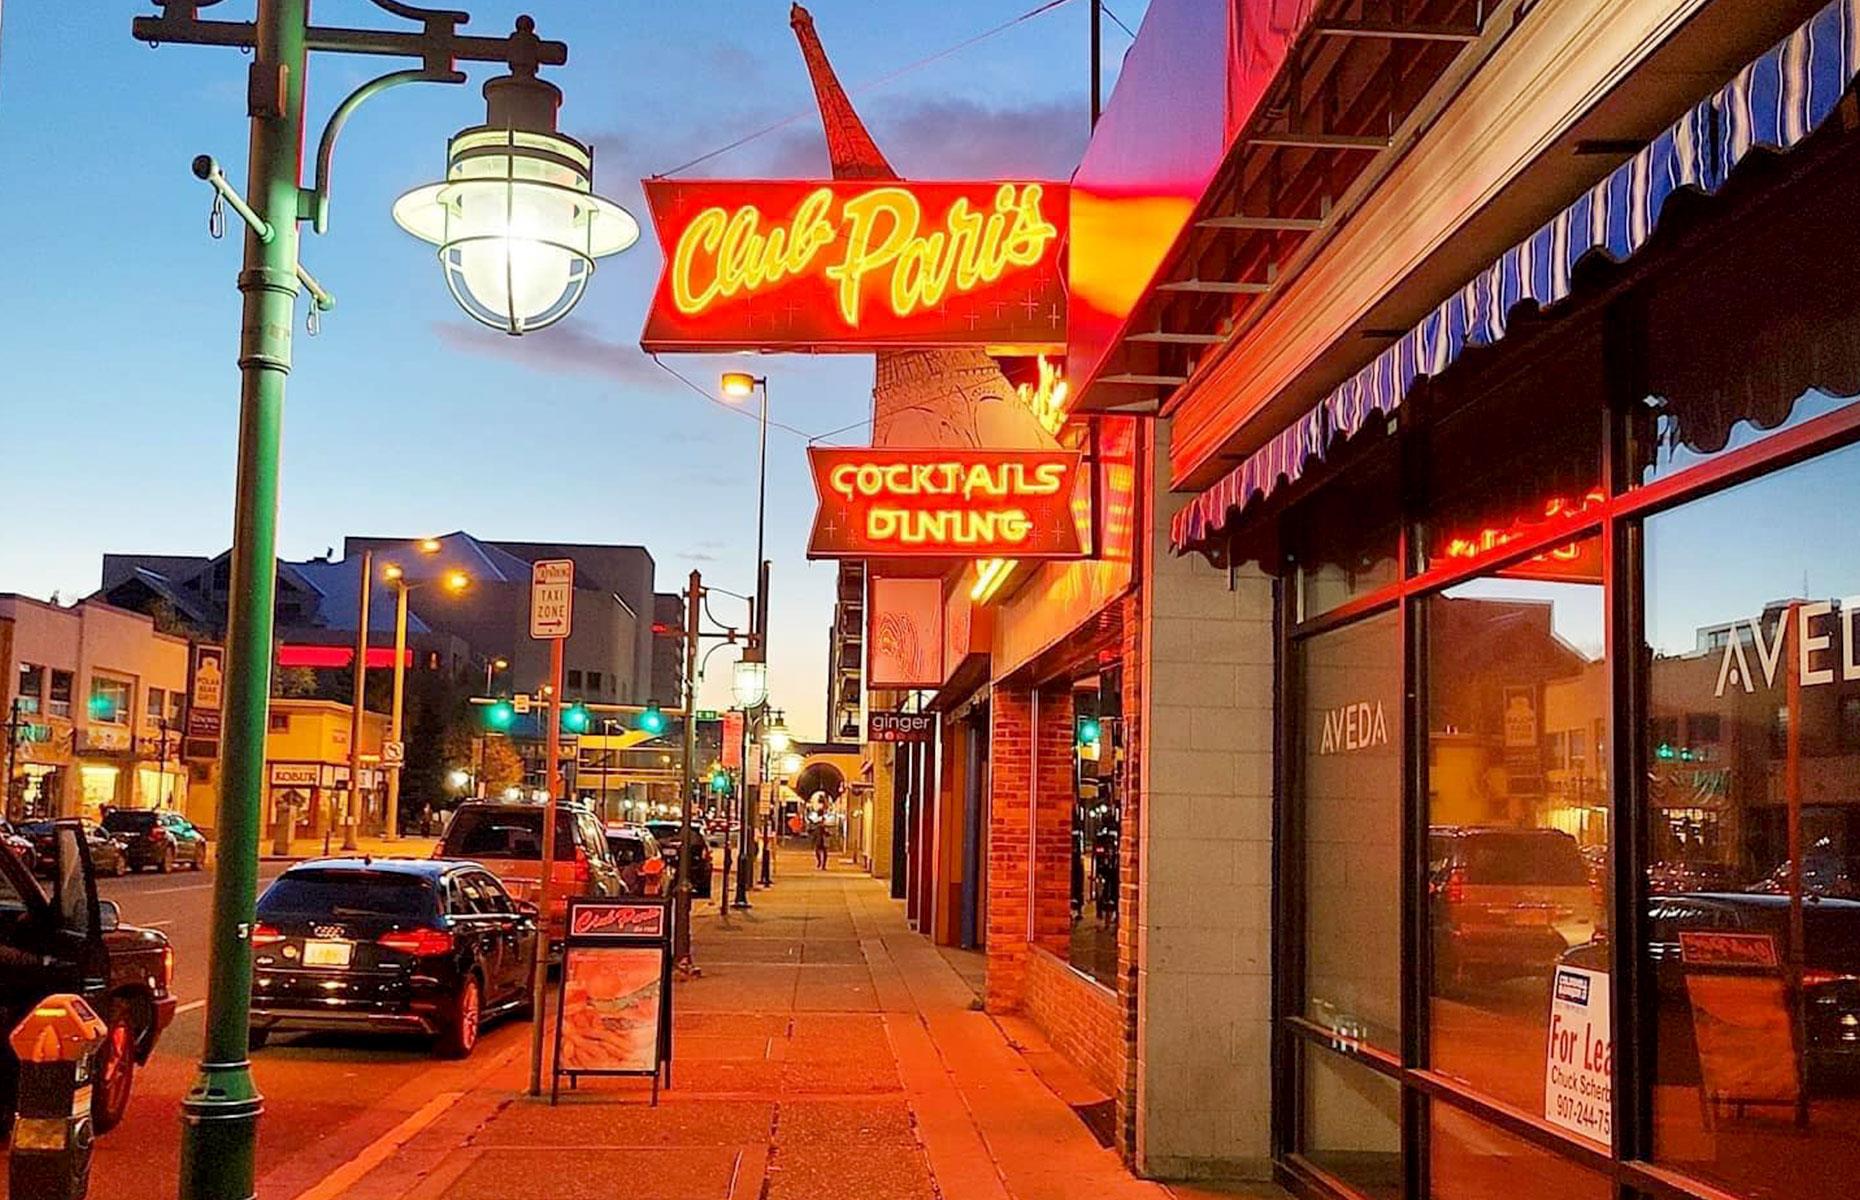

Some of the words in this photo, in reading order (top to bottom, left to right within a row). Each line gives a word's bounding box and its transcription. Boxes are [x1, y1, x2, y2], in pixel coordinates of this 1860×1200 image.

[673, 188, 836, 314] Club
[830, 463, 1068, 500] COCKTAILS
[866, 507, 1033, 543] DINING
[537, 605, 565, 618] ZONE
[541, 590, 563, 601] TAXI
[872, 713, 931, 733] ginger
[1320, 700, 1388, 755] AVEDA
[1551, 1014, 1578, 1064] For
[1551, 1065, 1578, 1092] Chuck
